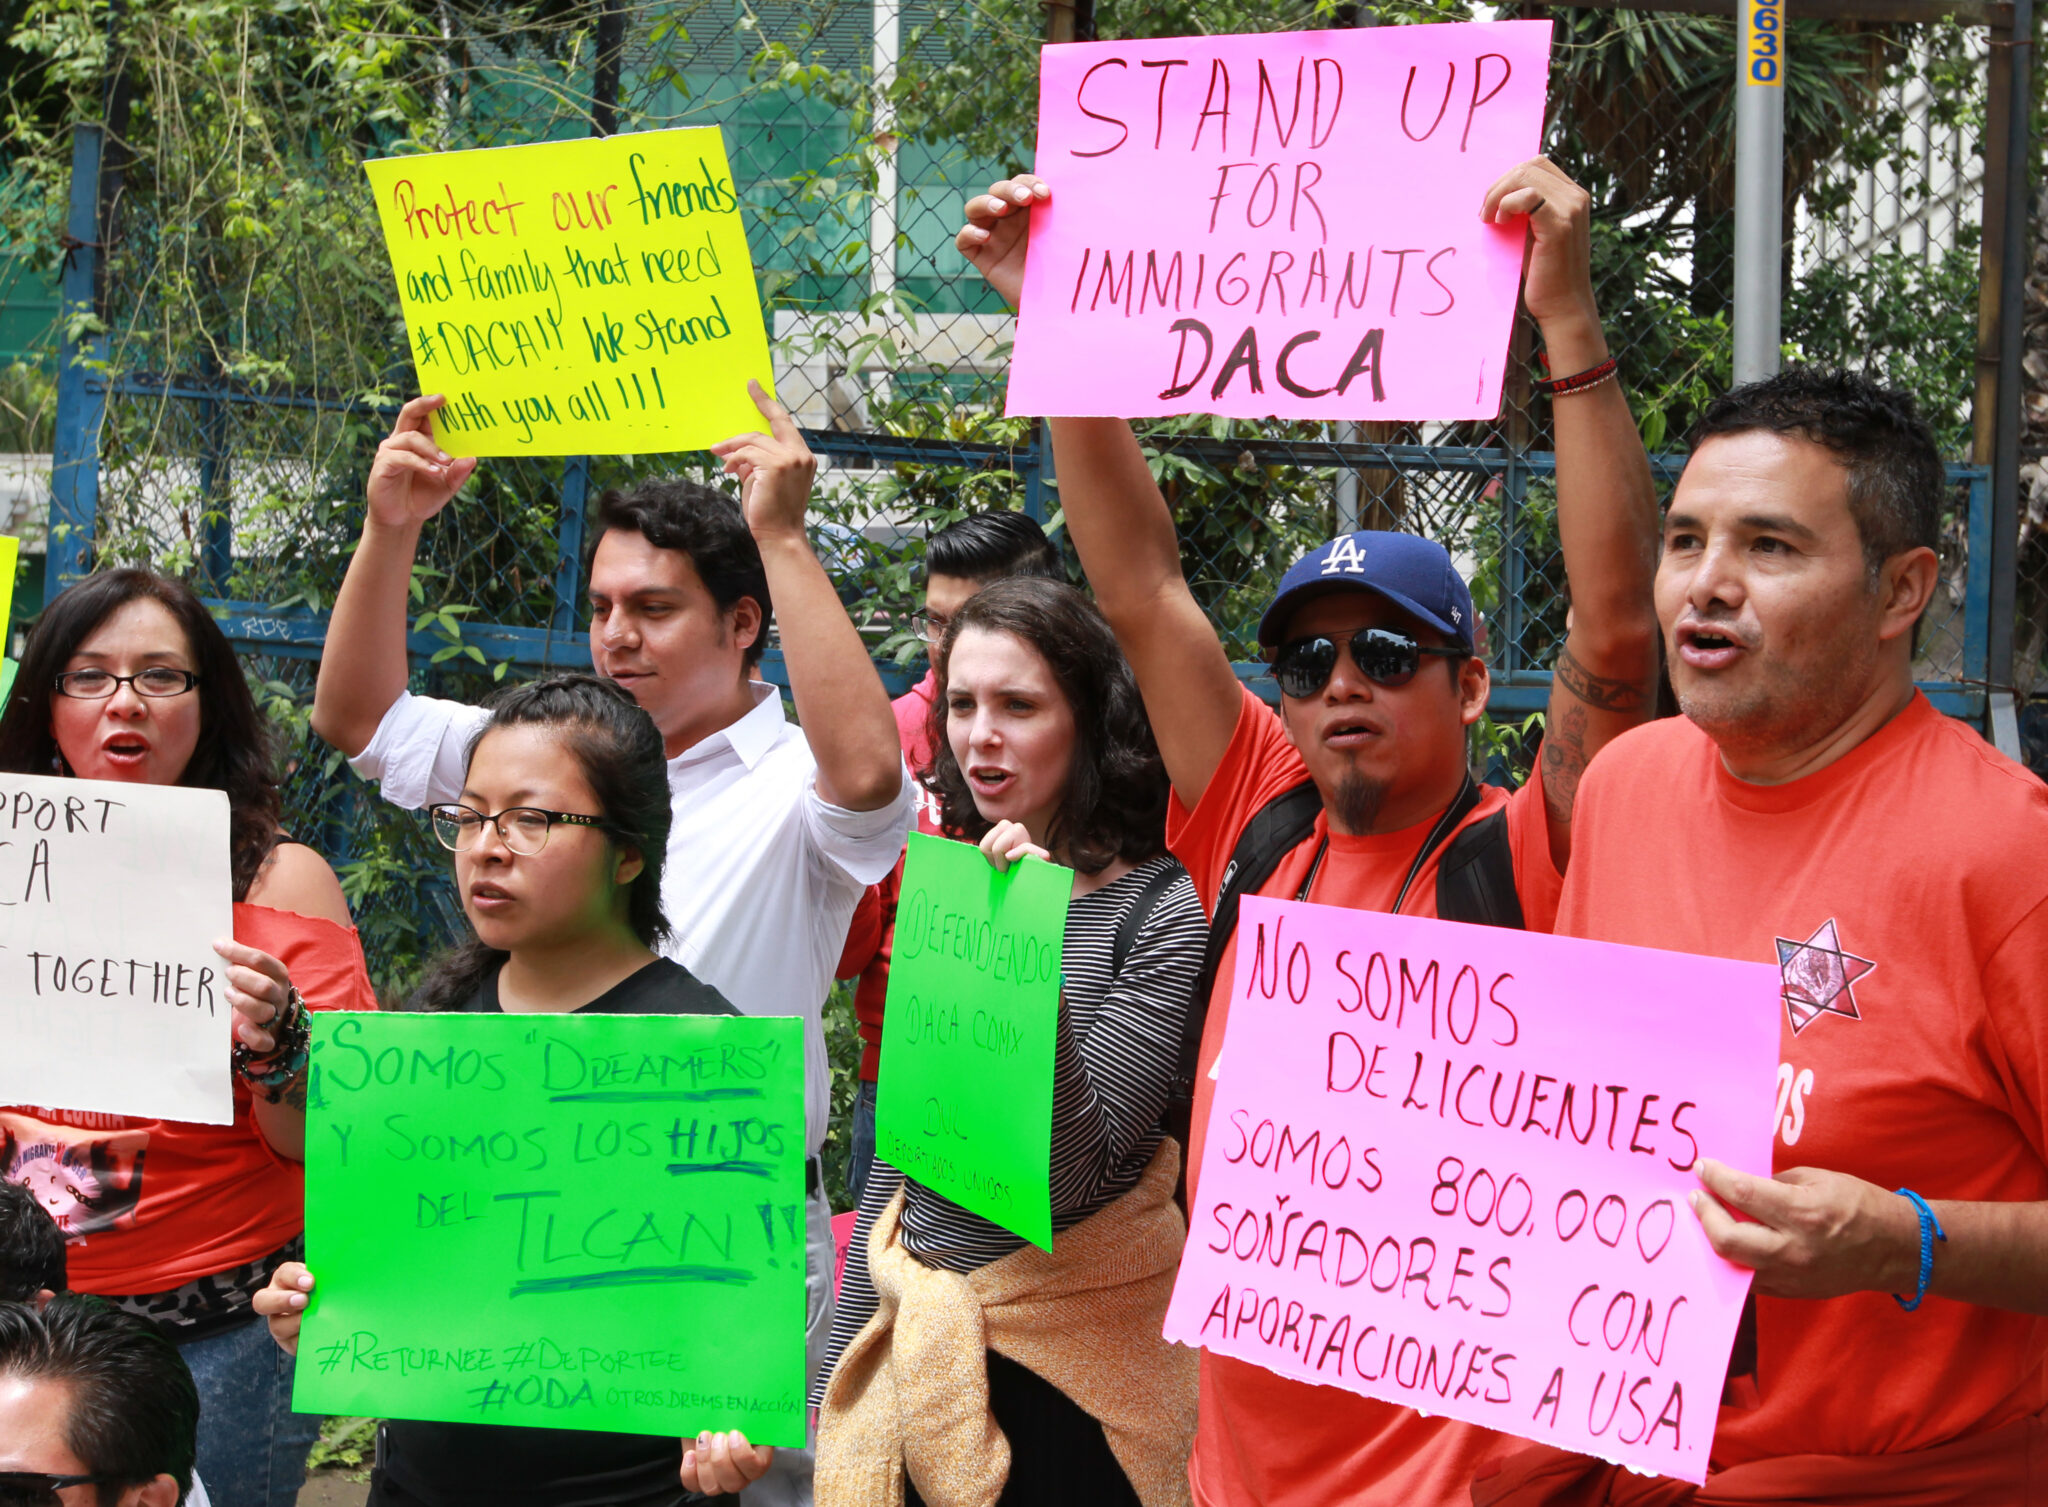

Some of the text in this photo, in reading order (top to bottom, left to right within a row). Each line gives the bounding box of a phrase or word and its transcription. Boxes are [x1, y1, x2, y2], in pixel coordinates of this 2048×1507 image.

[1752, 0, 1779, 81] 630
[1069, 53, 1511, 158] STAND UP
[394, 152, 738, 240] Protect our friends
[1209, 161, 1328, 245] FOR
[407, 230, 722, 325] and family that need
[1071, 245, 1457, 318] IMMIGRANTS
[415, 307, 573, 374] #DACA!!
[583, 311, 629, 363] We
[1158, 318, 1386, 403] DACA
[436, 391, 498, 434] with
[502, 394, 562, 443] you
[1320, 533, 1367, 576] LA
[0, 791, 126, 833] PORT
[0, 838, 51, 905] A
[902, 888, 1053, 986] DEFENDIENDO
[27, 951, 215, 1017] TOGETHER
[905, 995, 958, 1045] DACA
[1246, 914, 1519, 1047] NO SOMOS
[331, 1114, 785, 1171] Y SOMOS LOS HIJOS
[1326, 1031, 1700, 1173] DELICUENTES
[888, 1130, 1014, 1211] DEPORTADOS UNIDOS
[1223, 1108, 1383, 1194] SOMOS
[416, 1192, 488, 1229] DEL
[1208, 1195, 1688, 1367] SOÑADORES CON
[316, 1331, 687, 1377] #RETURNEE #DEPORTEE
[1200, 1284, 1694, 1453] APORTACIONES A USA.
[466, 1375, 801, 1416] #ODA OTROS DREMS EN ACCIÓN
